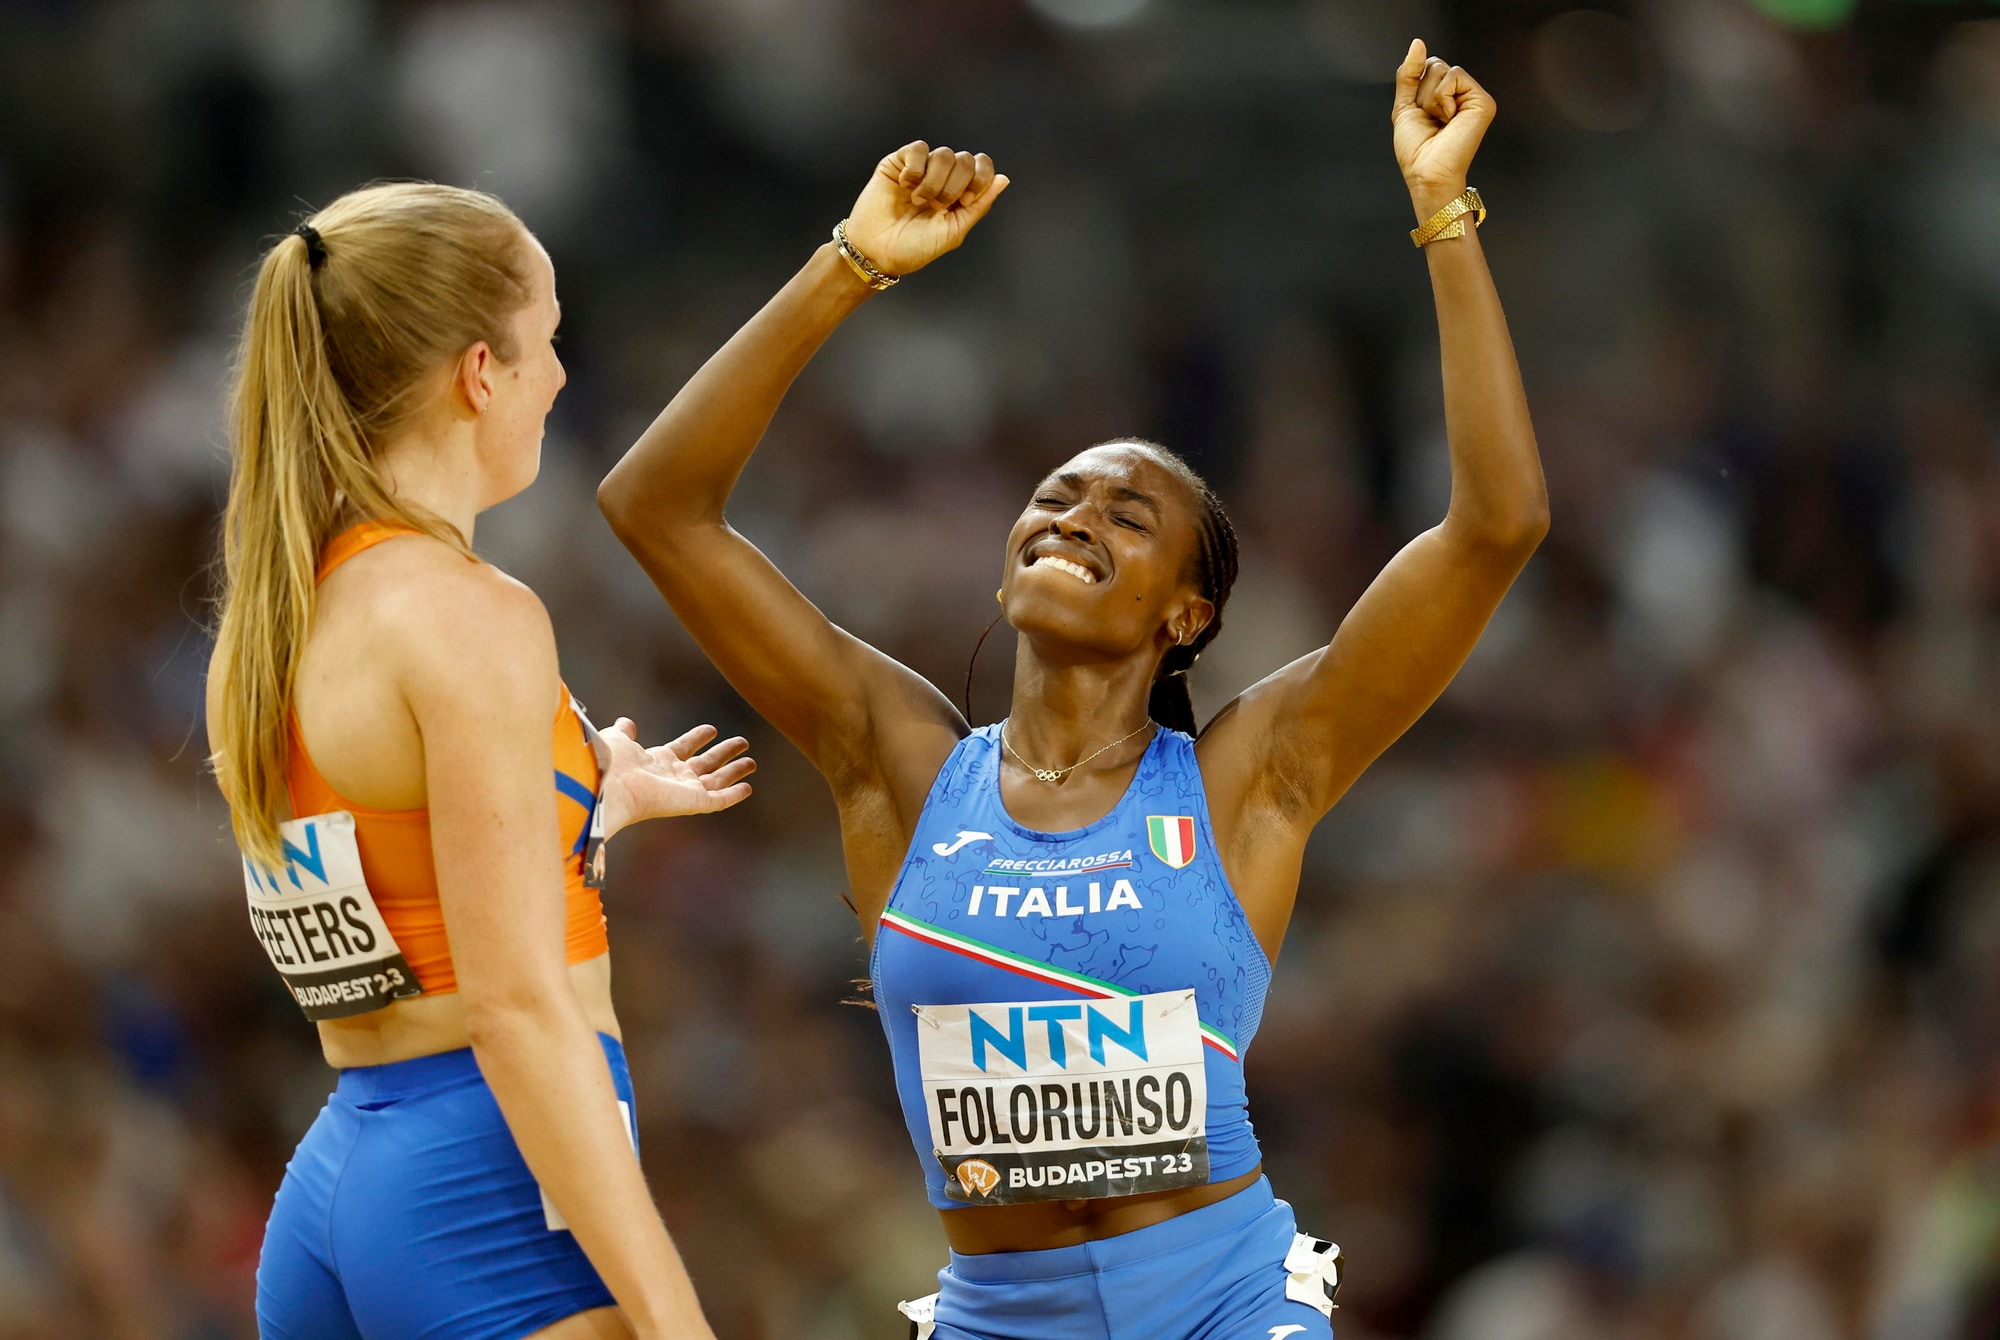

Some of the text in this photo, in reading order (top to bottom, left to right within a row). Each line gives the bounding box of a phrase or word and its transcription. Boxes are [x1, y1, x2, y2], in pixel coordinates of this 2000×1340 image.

[987, 849, 1133, 871] FRECCIAROSSA
[967, 879, 1143, 918] ITALIA
[250, 895, 377, 966] PEETERS
[294, 967, 405, 1007] BUDAPEST 23
[968, 1000, 1149, 1074] NTN
[936, 1071, 1193, 1147] FOLORUNSO
[1009, 1152, 1193, 1188] BUDAPEST 23
